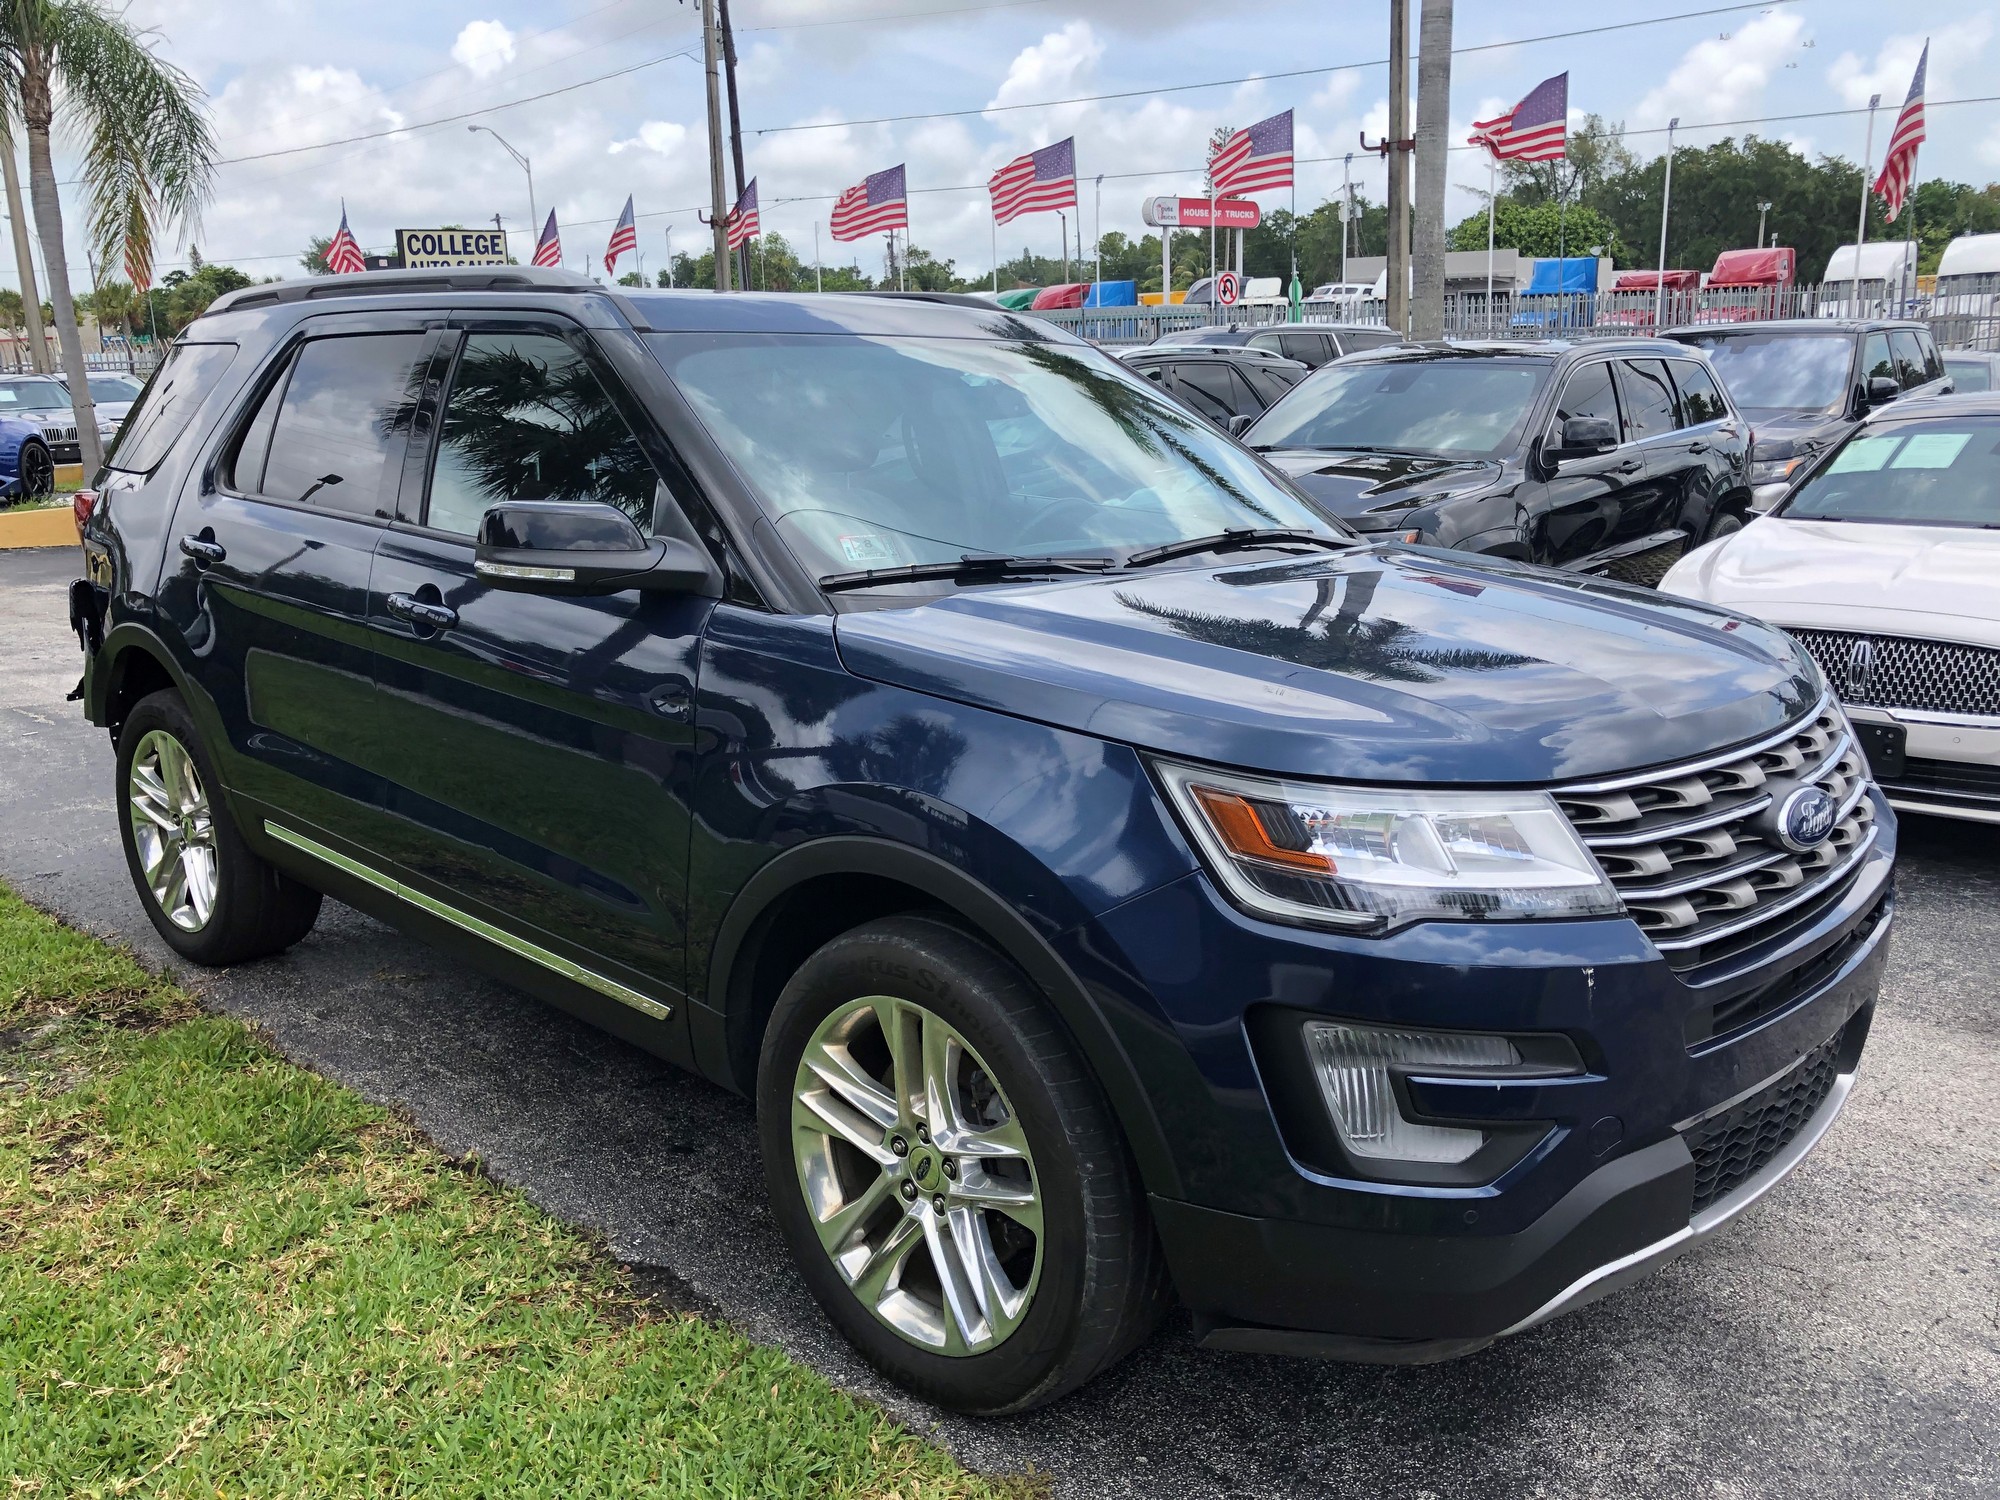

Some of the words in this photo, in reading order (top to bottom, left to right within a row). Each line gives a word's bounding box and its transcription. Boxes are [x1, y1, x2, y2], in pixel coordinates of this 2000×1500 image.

[1183, 208, 1209, 217] HOUSE
[1213, 209, 1222, 218] OF
[1225, 209, 1255, 219] TRUCKS
[407, 234, 503, 256] COLLEGE
[1801, 797, 1832, 837] Ford
